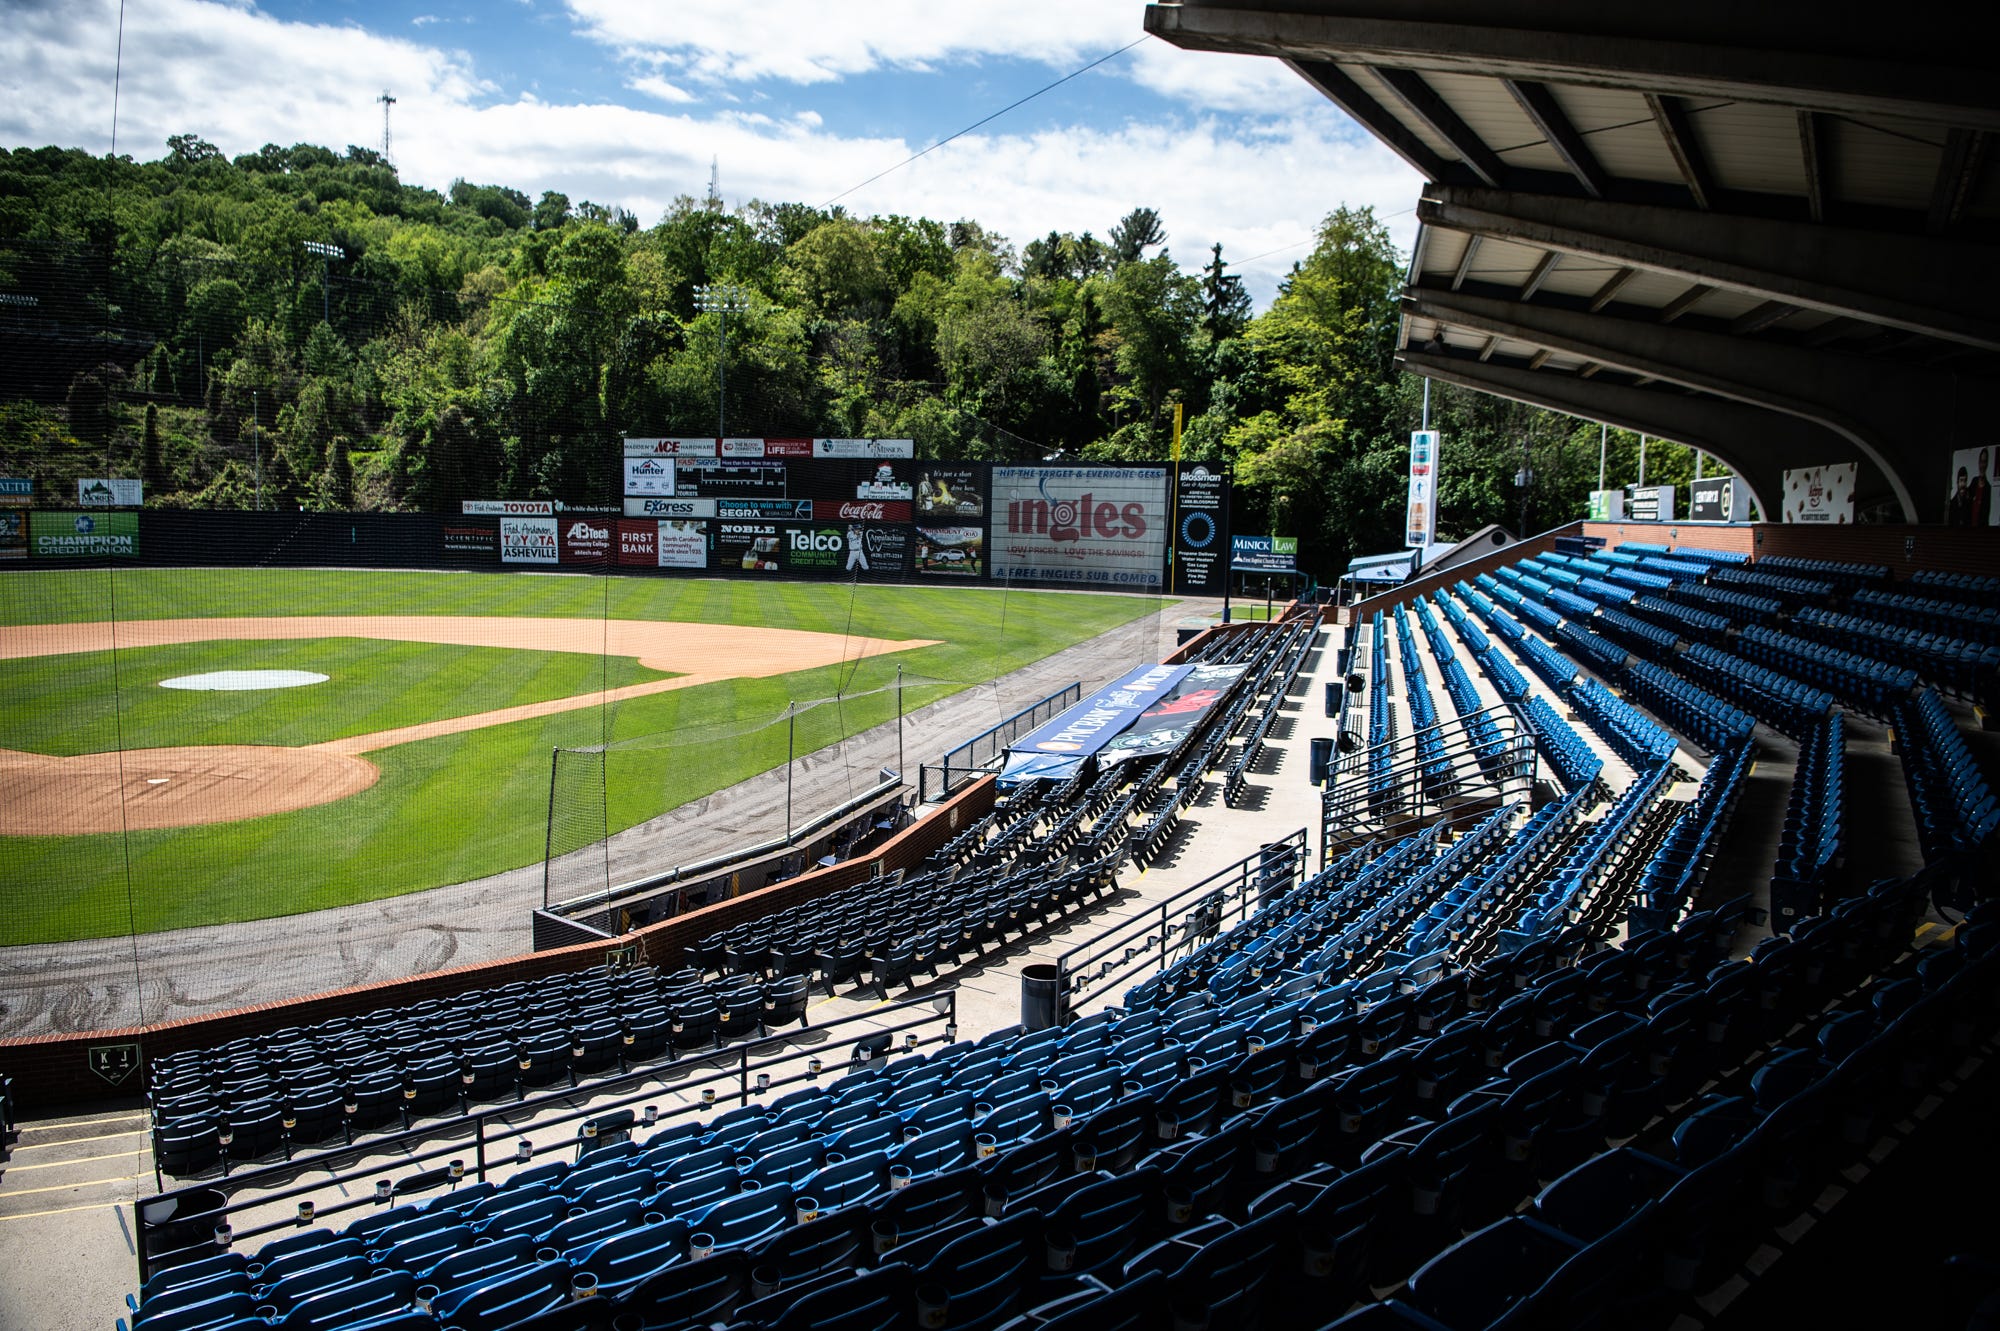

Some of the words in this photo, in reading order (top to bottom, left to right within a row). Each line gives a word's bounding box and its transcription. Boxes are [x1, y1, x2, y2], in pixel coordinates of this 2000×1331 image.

[654, 440, 680, 453] ACE
[632, 466, 664, 474] Hunter
[1180, 472, 1221, 481] Blossman
[504, 503, 550, 513] TOYOTA
[1008, 490, 1146, 543] ingles
[504, 523, 520, 535] Fred
[721, 525, 775, 533] NOBLE
[39, 536, 132, 545] CHAMPION
[622, 533, 653, 542] FIRST
[786, 530, 842, 551] Telco
[622, 544, 653, 553] BANK
[1234, 539, 1270, 550] MINICK
[40, 546, 86, 554] CREDIT
[504, 548, 556, 558] ASHEVILLE
[1009, 569, 1036, 577] FREE
[1041, 570, 1082, 579] INGLES
[1086, 572, 1109, 581] SUB
[1113, 573, 1158, 583] COMBO
[101, 1053, 108, 1063] K
[121, 1051, 127, 1061] J
